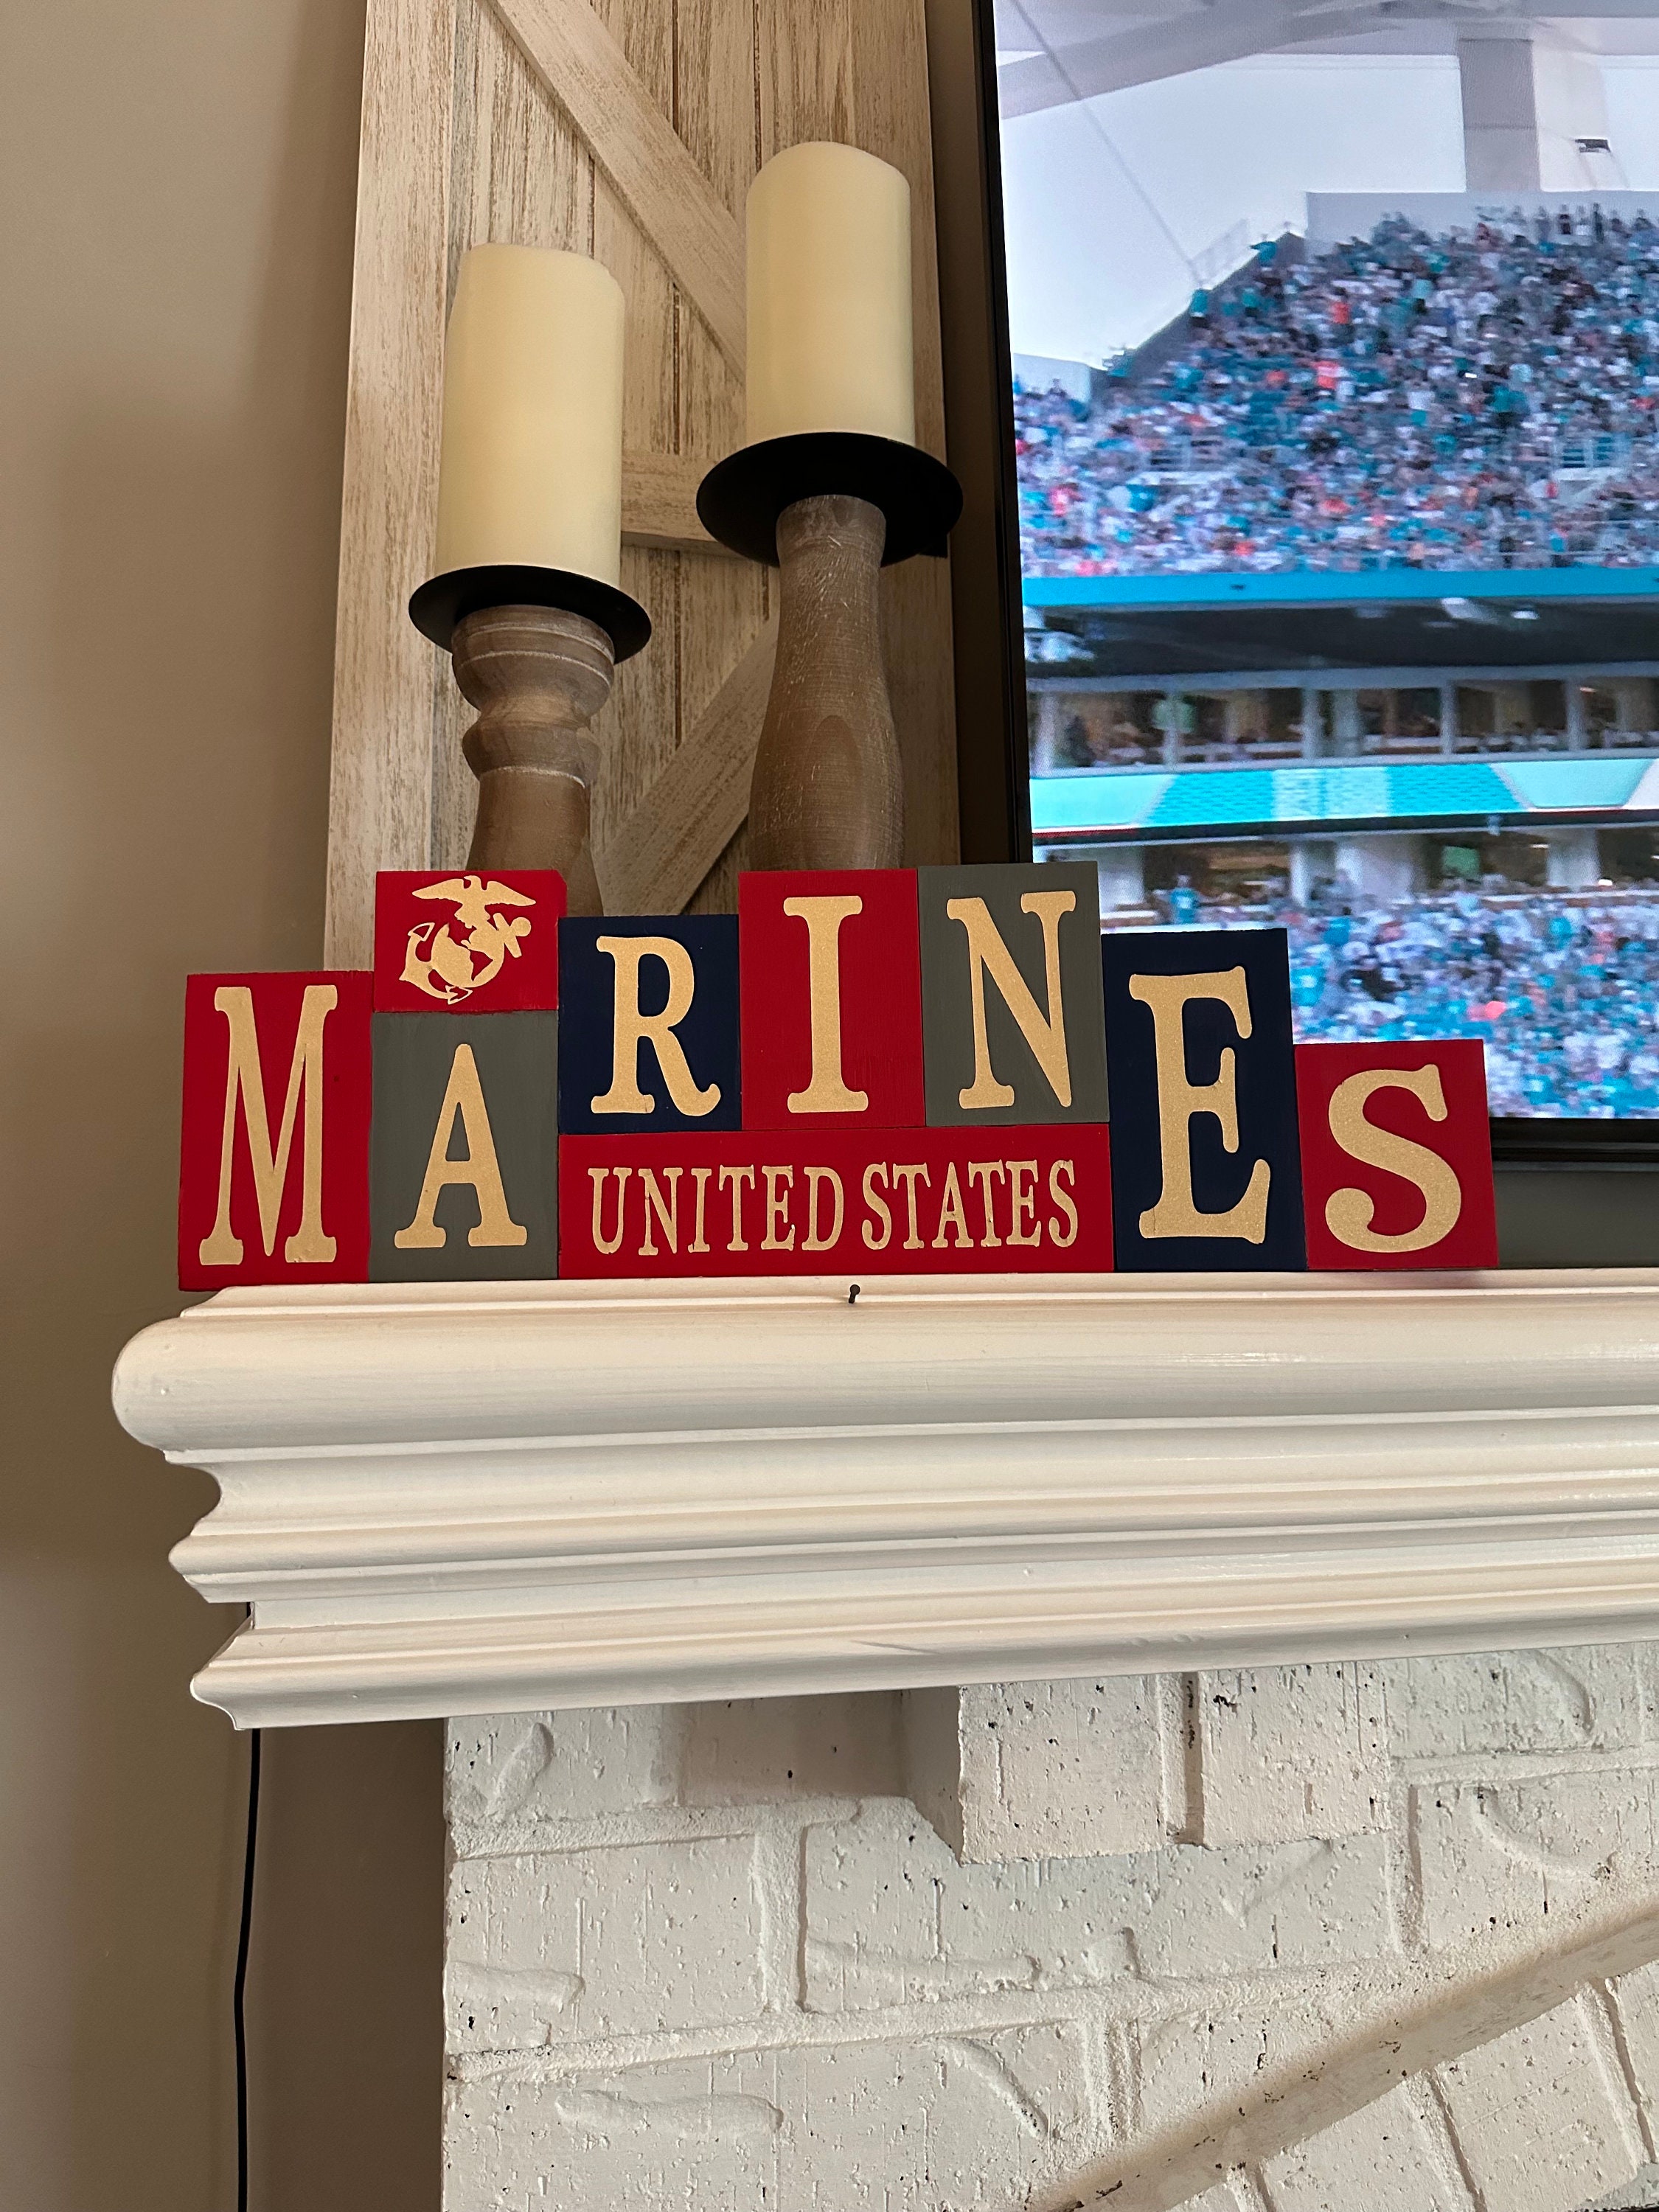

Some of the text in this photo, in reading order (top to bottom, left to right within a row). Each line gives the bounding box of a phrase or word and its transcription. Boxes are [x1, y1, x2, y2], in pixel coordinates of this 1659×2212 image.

[198, 889, 1462, 1266] MARINES
[587, 1158, 1079, 1256] UNITED STATES
